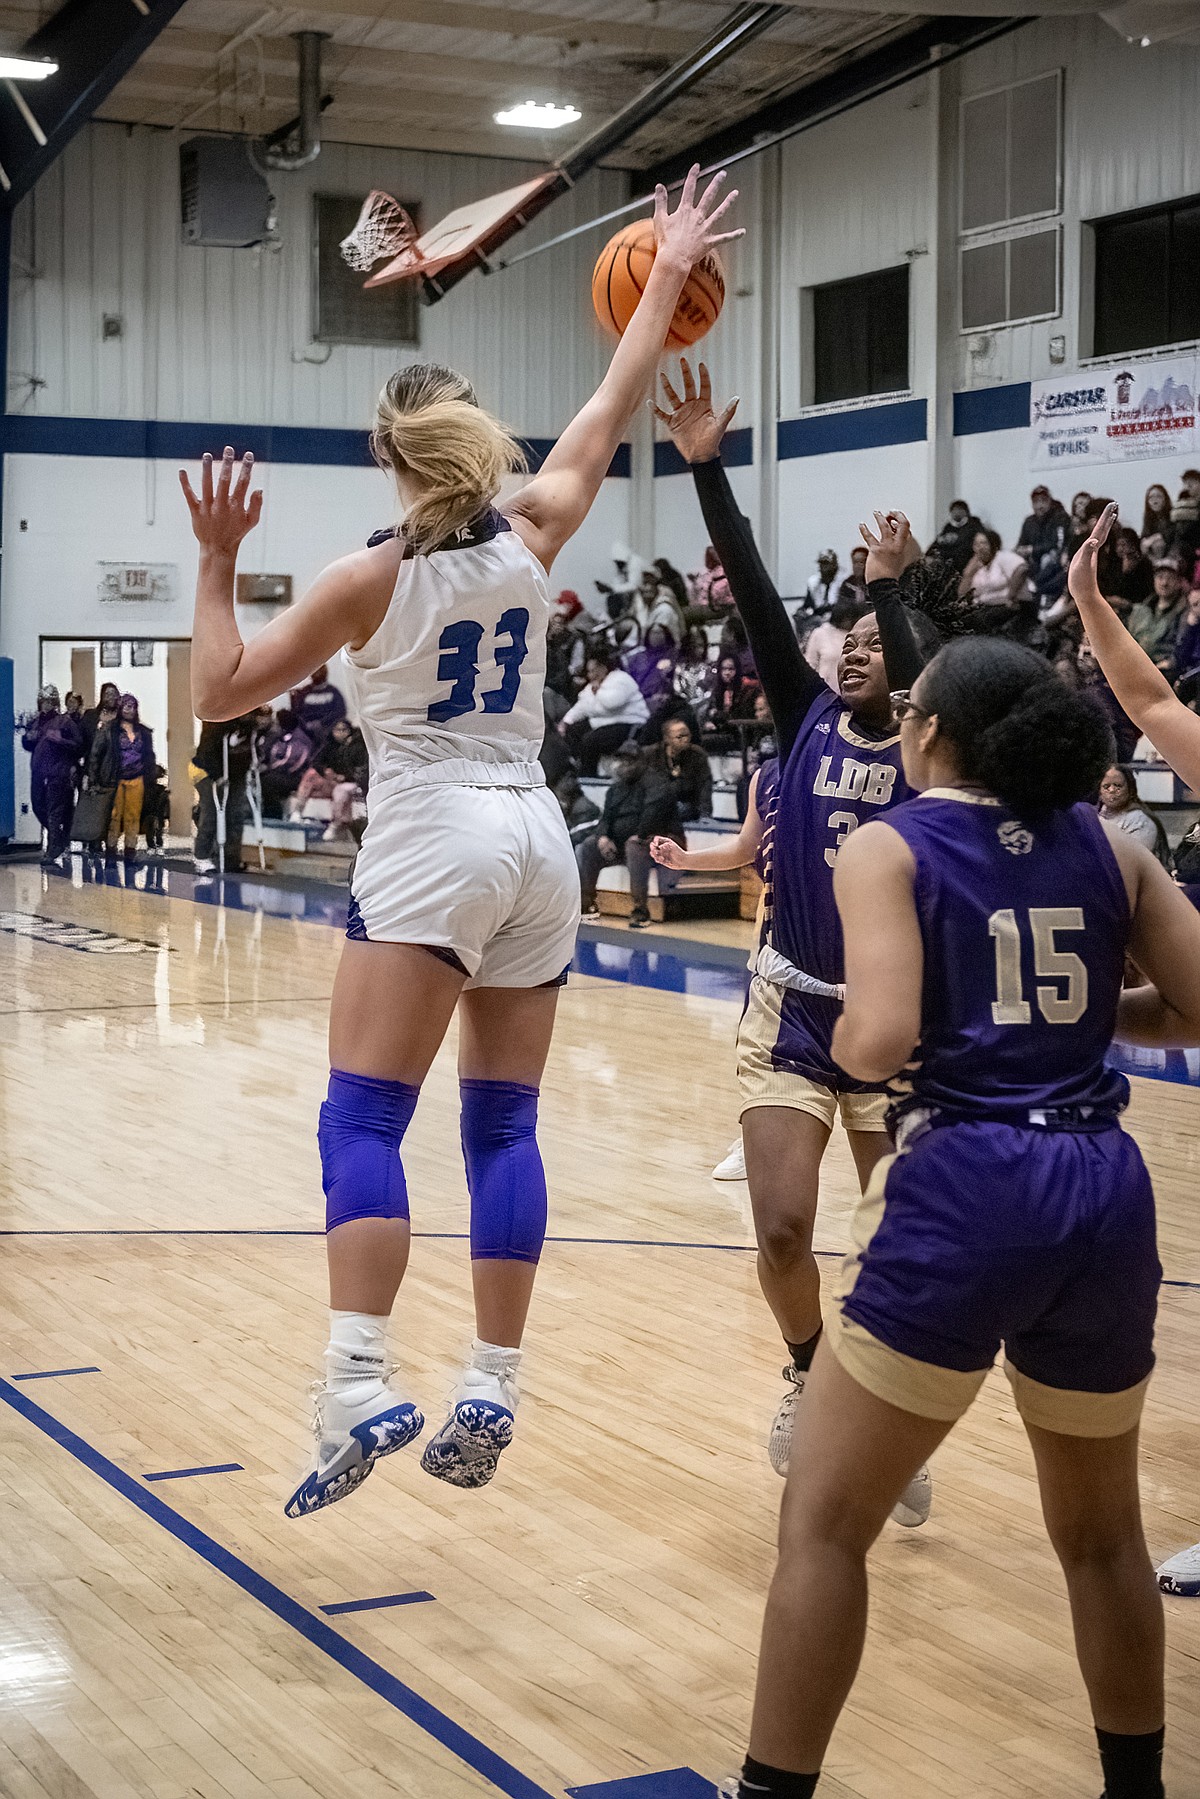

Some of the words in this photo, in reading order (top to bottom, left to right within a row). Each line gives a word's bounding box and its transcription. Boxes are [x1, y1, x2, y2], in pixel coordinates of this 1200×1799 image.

[427, 607, 529, 723] 33
[813, 755, 897, 805] LDB
[824, 810, 859, 868] 3
[988, 907, 1088, 1025] 15
